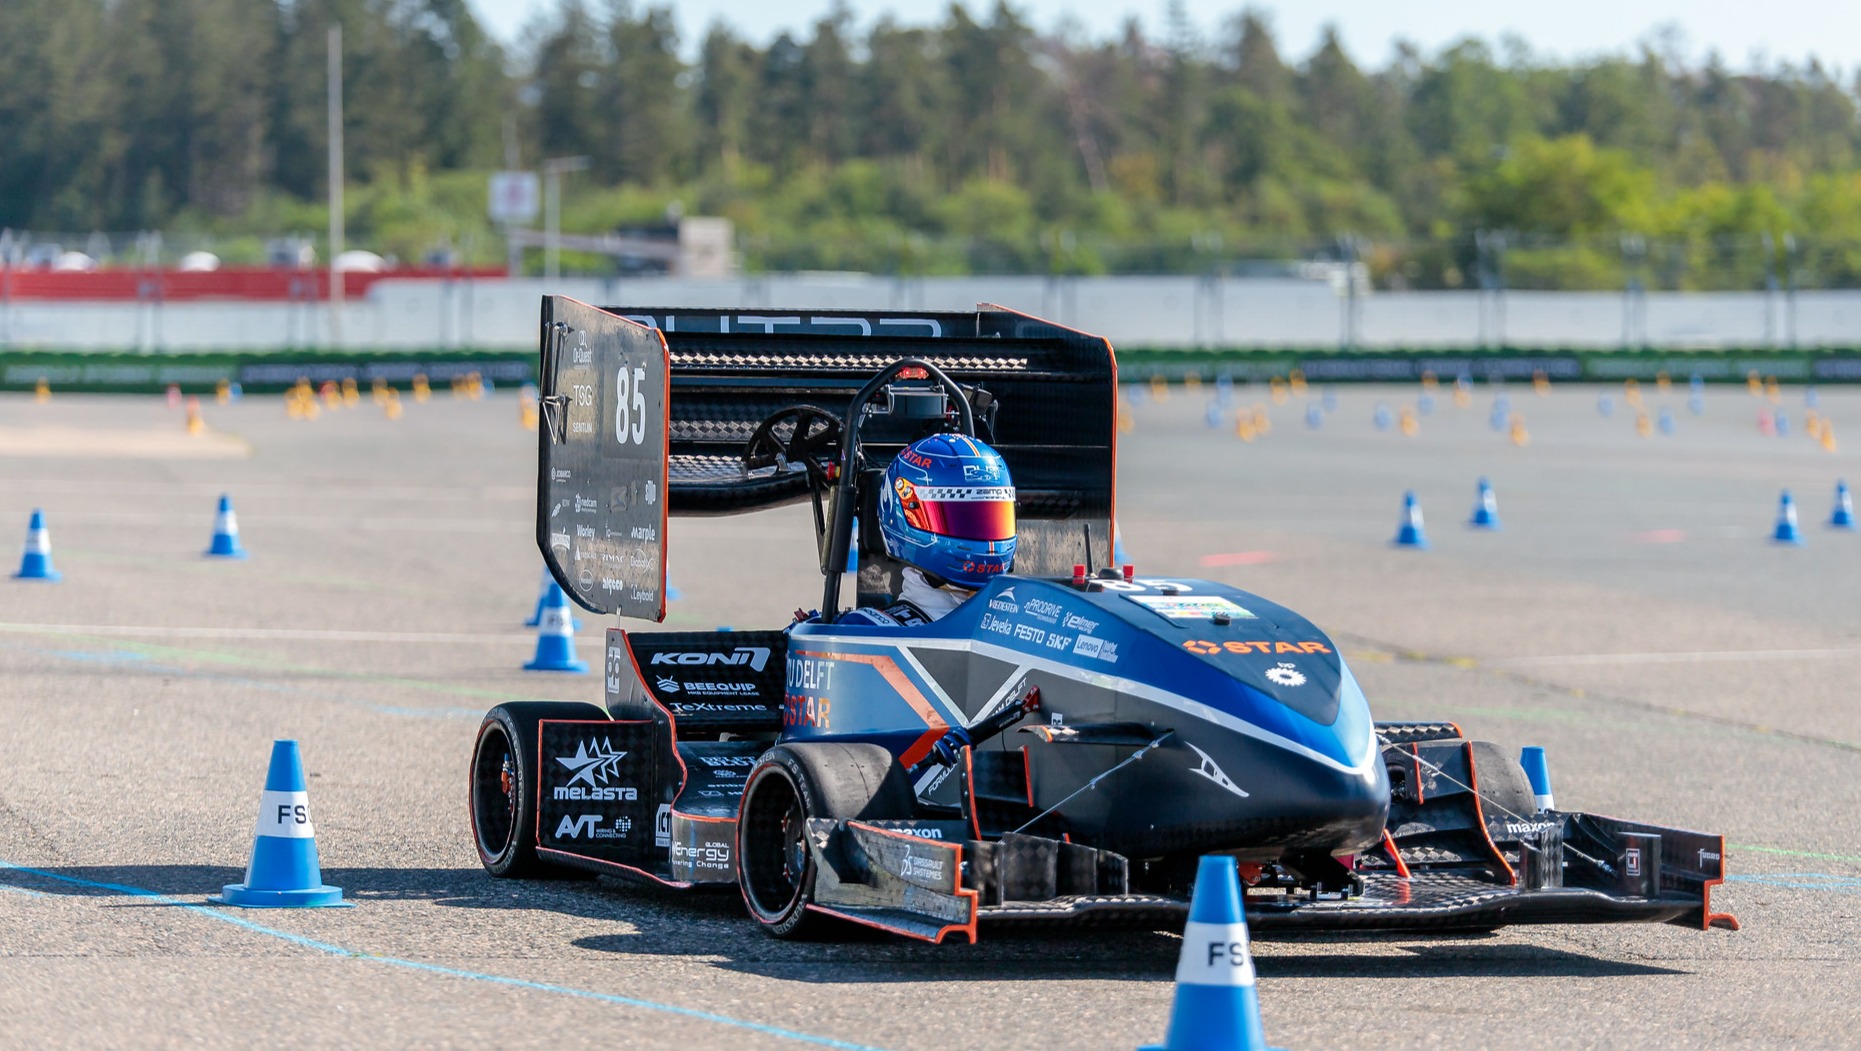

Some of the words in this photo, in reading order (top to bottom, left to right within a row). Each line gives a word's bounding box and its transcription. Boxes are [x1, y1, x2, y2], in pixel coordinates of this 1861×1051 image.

[573, 385, 592, 406] TSG
[616, 366, 646, 445] 85
[577, 524, 595, 541] Worley
[1089, 579, 1193, 592] 85
[1030, 598, 1062, 618] PRODRIVE
[988, 614, 1012, 636] Jeveka
[1014, 624, 1046, 644] FESTO
[1046, 633, 1072, 651] SKF
[1076, 638, 1099, 653] Lenovo
[1222, 641, 1332, 655] STAR
[651, 650, 756, 667] KONI
[796, 659, 835, 690] DELFT
[683, 682, 756, 691] BEEQUIP
[789, 695, 831, 728] STAR
[277, 804, 312, 825] FS
[696, 860, 729, 869] Change
[913, 856, 943, 870] DASSAULT
[1207, 942, 1244, 966] FS
